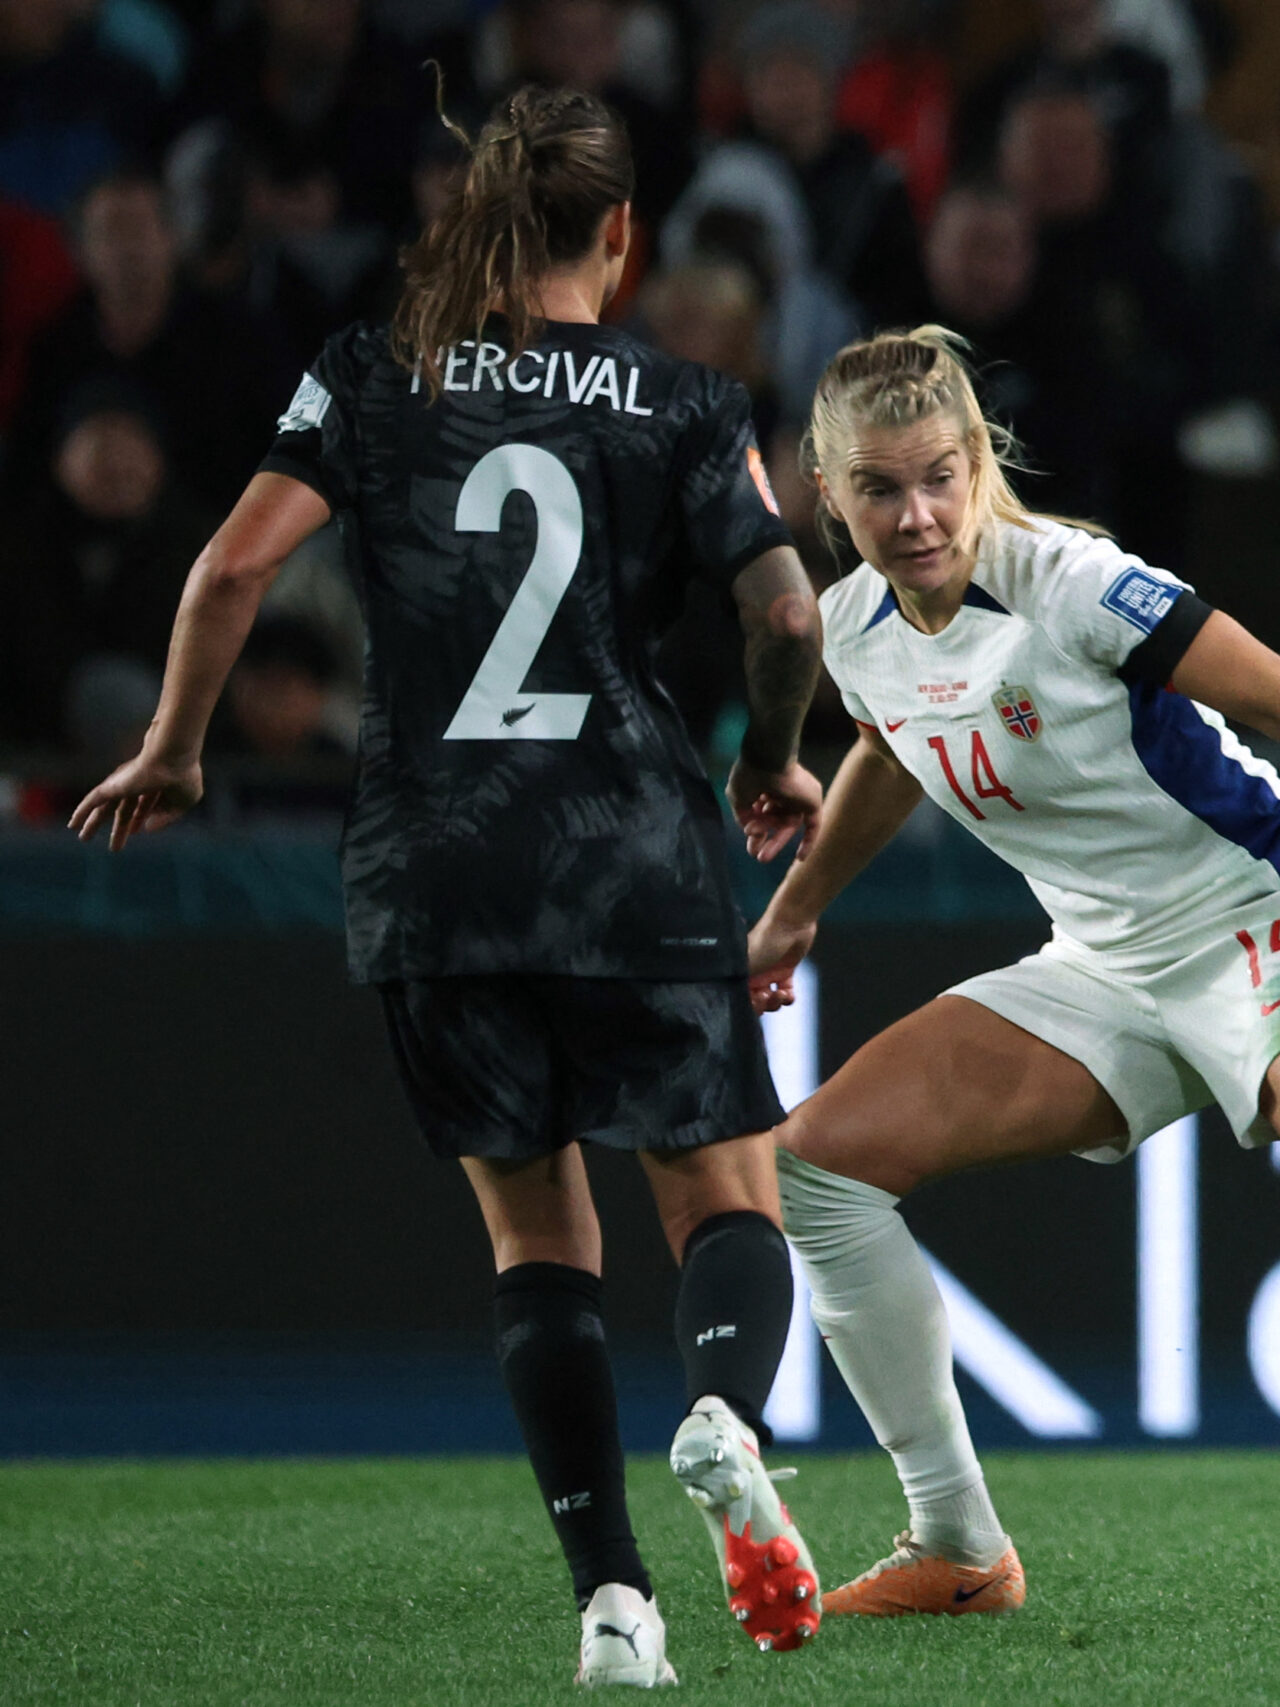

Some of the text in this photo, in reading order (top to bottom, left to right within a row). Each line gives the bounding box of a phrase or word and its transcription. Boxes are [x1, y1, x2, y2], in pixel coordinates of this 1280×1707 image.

[442, 443, 593, 740] 2
[1124, 581, 1157, 610] UNITES
[928, 730, 1025, 821] 14
[696, 1324, 737, 1347] NZ
[553, 1491, 591, 1515] NZ
